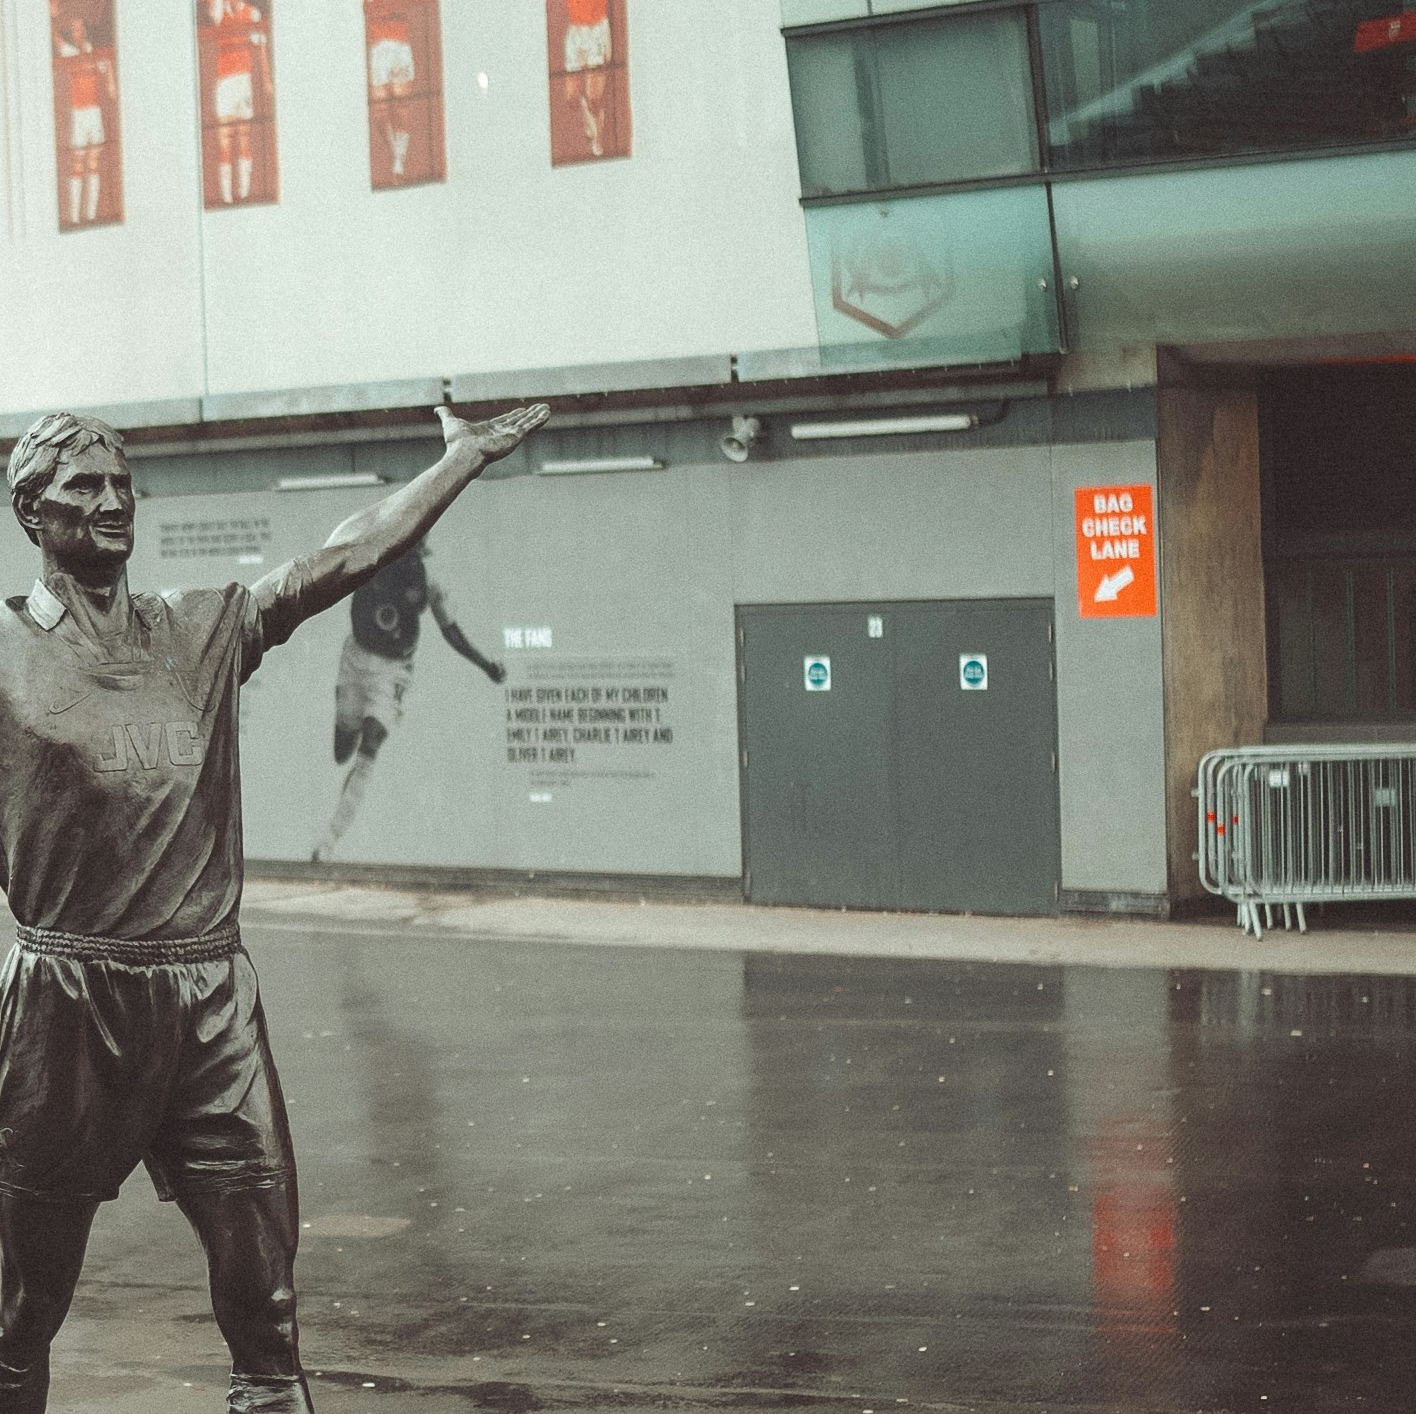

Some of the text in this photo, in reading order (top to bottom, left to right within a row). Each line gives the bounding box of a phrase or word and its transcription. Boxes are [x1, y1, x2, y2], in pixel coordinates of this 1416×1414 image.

[1093, 493, 1134, 514] BAG
[1081, 516, 1147, 538] CHECK
[1089, 538, 1141, 560] LANE
[510, 687, 532, 704] HAVE
[535, 687, 563, 704] GIVEN
[564, 687, 590, 704] EACH
[591, 687, 602, 704] OF
[605, 687, 620, 704] MY
[621, 687, 669, 704] CHILDREN
[549, 707, 574, 723] NAME
[577, 707, 626, 723] BEGINNING
[628, 707, 653, 723] WITH
[652, 727, 674, 744] AND
[93, 720, 204, 773] JVC
